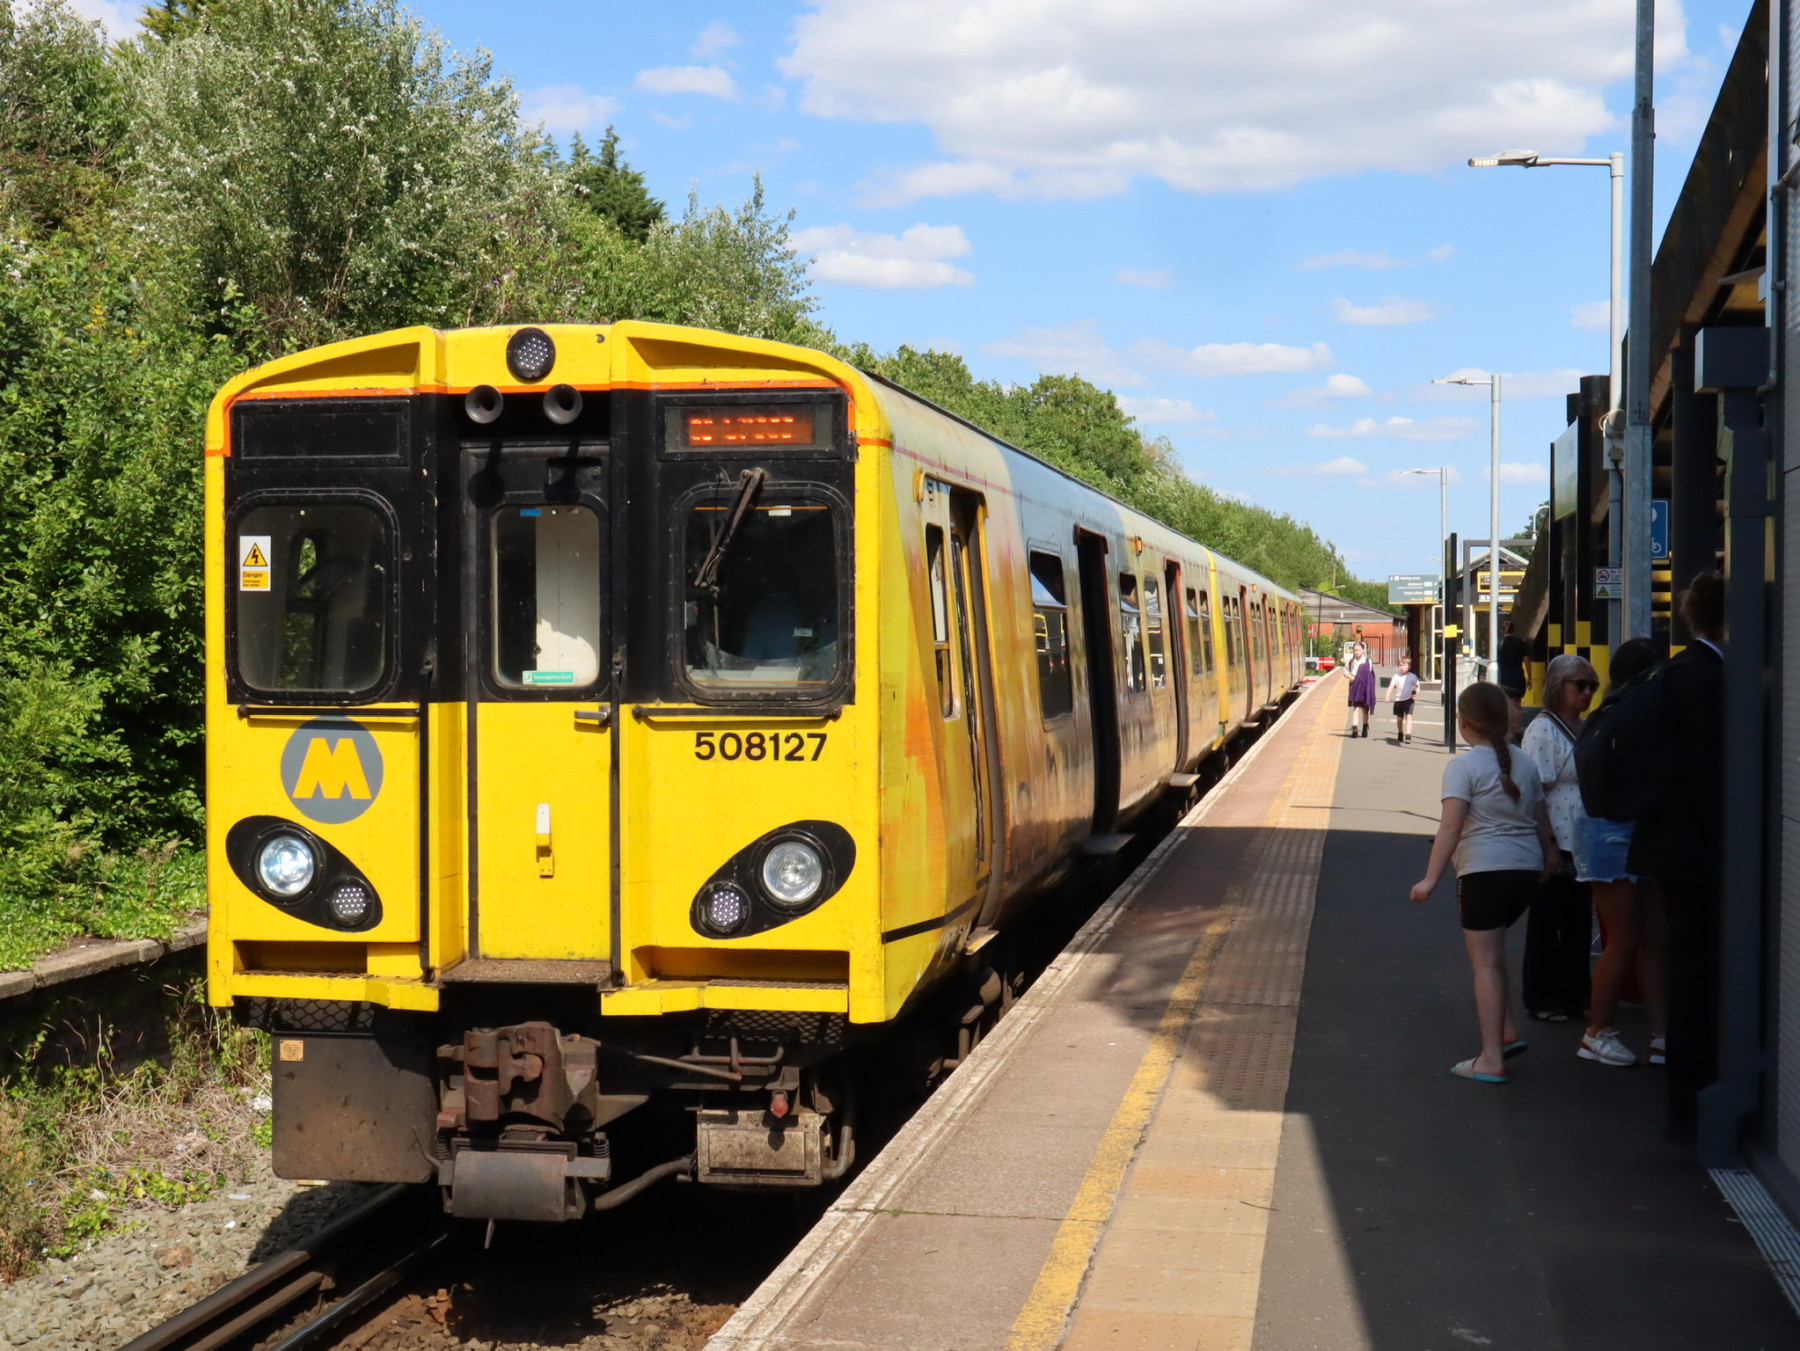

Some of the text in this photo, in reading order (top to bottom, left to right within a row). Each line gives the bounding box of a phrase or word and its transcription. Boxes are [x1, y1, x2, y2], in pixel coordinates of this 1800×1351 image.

[242, 571, 264, 579] Danger
[694, 731, 828, 762] 508127
[292, 737, 372, 800] M
